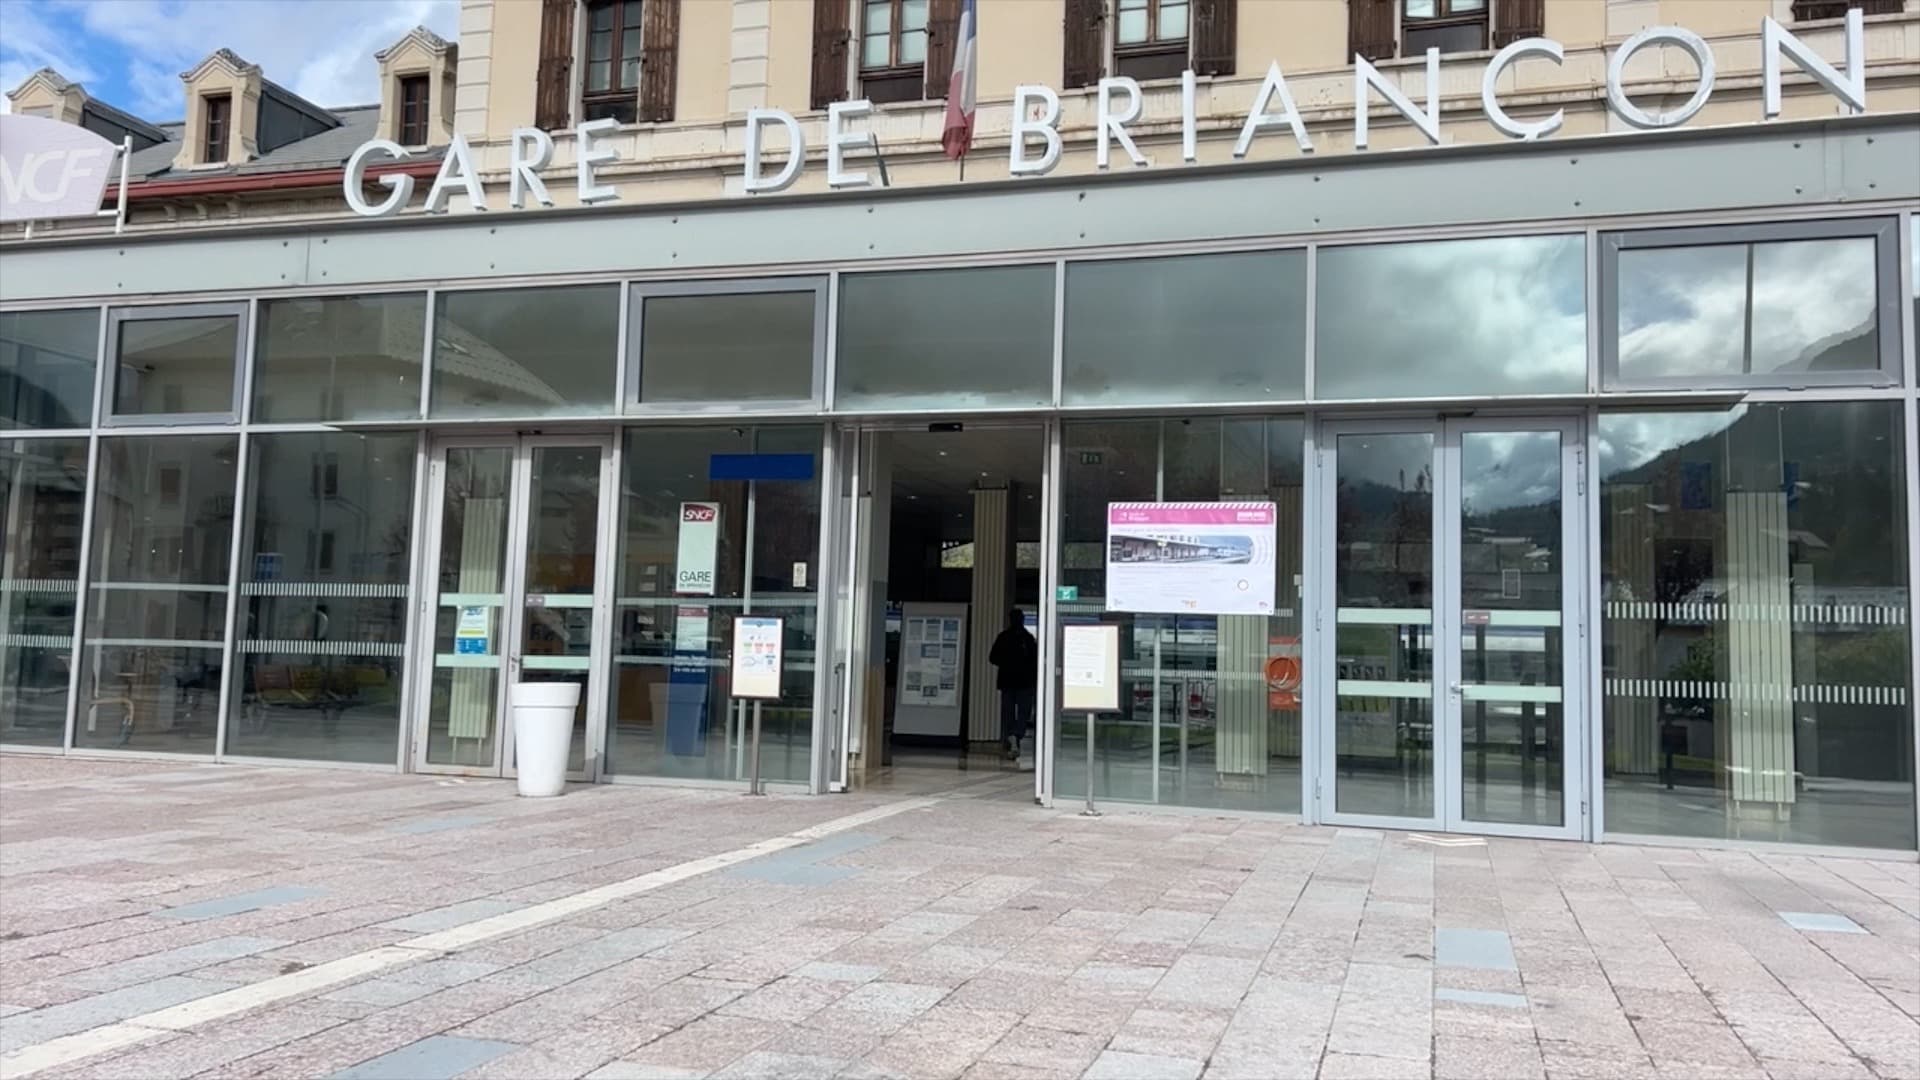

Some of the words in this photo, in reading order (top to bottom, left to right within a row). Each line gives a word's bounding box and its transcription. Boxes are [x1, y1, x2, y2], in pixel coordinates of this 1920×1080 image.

[344, 117, 621, 217] GARE
[745, 99, 874, 194] DE
[1009, 8, 1867, 176] BRIANÇON
[679, 570, 712, 583] GARE
